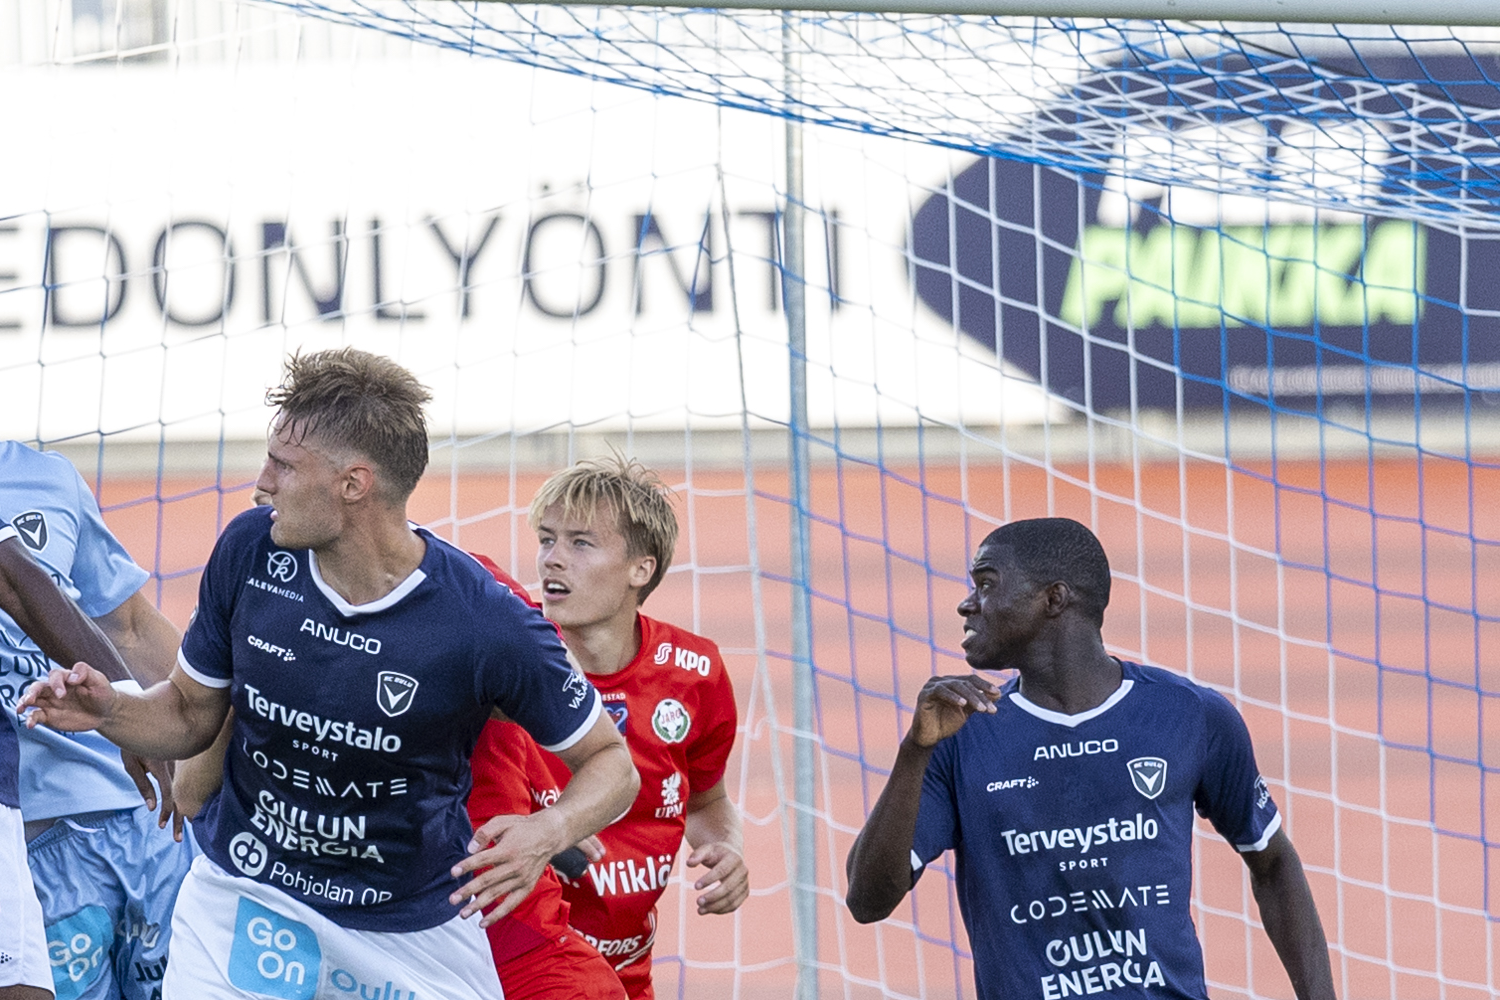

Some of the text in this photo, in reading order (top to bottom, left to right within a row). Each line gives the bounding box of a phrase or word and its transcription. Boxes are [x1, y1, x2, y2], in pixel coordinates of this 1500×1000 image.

[247, 634, 286, 658] CRAFT
[299, 617, 382, 655] ANUCO
[674, 646, 712, 678] KPO
[244, 683, 402, 753] Terveystalo
[292, 739, 339, 763] SPORT
[1033, 738, 1120, 762] ANUCO
[986, 777, 1027, 793] CRAFT
[250, 802, 386, 864] ENERGIA
[258, 789, 367, 842] OULUN
[1000, 812, 1159, 857] Terveystalo
[587, 854, 673, 897] Wiklö
[1058, 857, 1109, 872] SPORT
[268, 861, 355, 905] Pohjolan
[246, 916, 297, 952] Go
[257, 950, 306, 986] On
